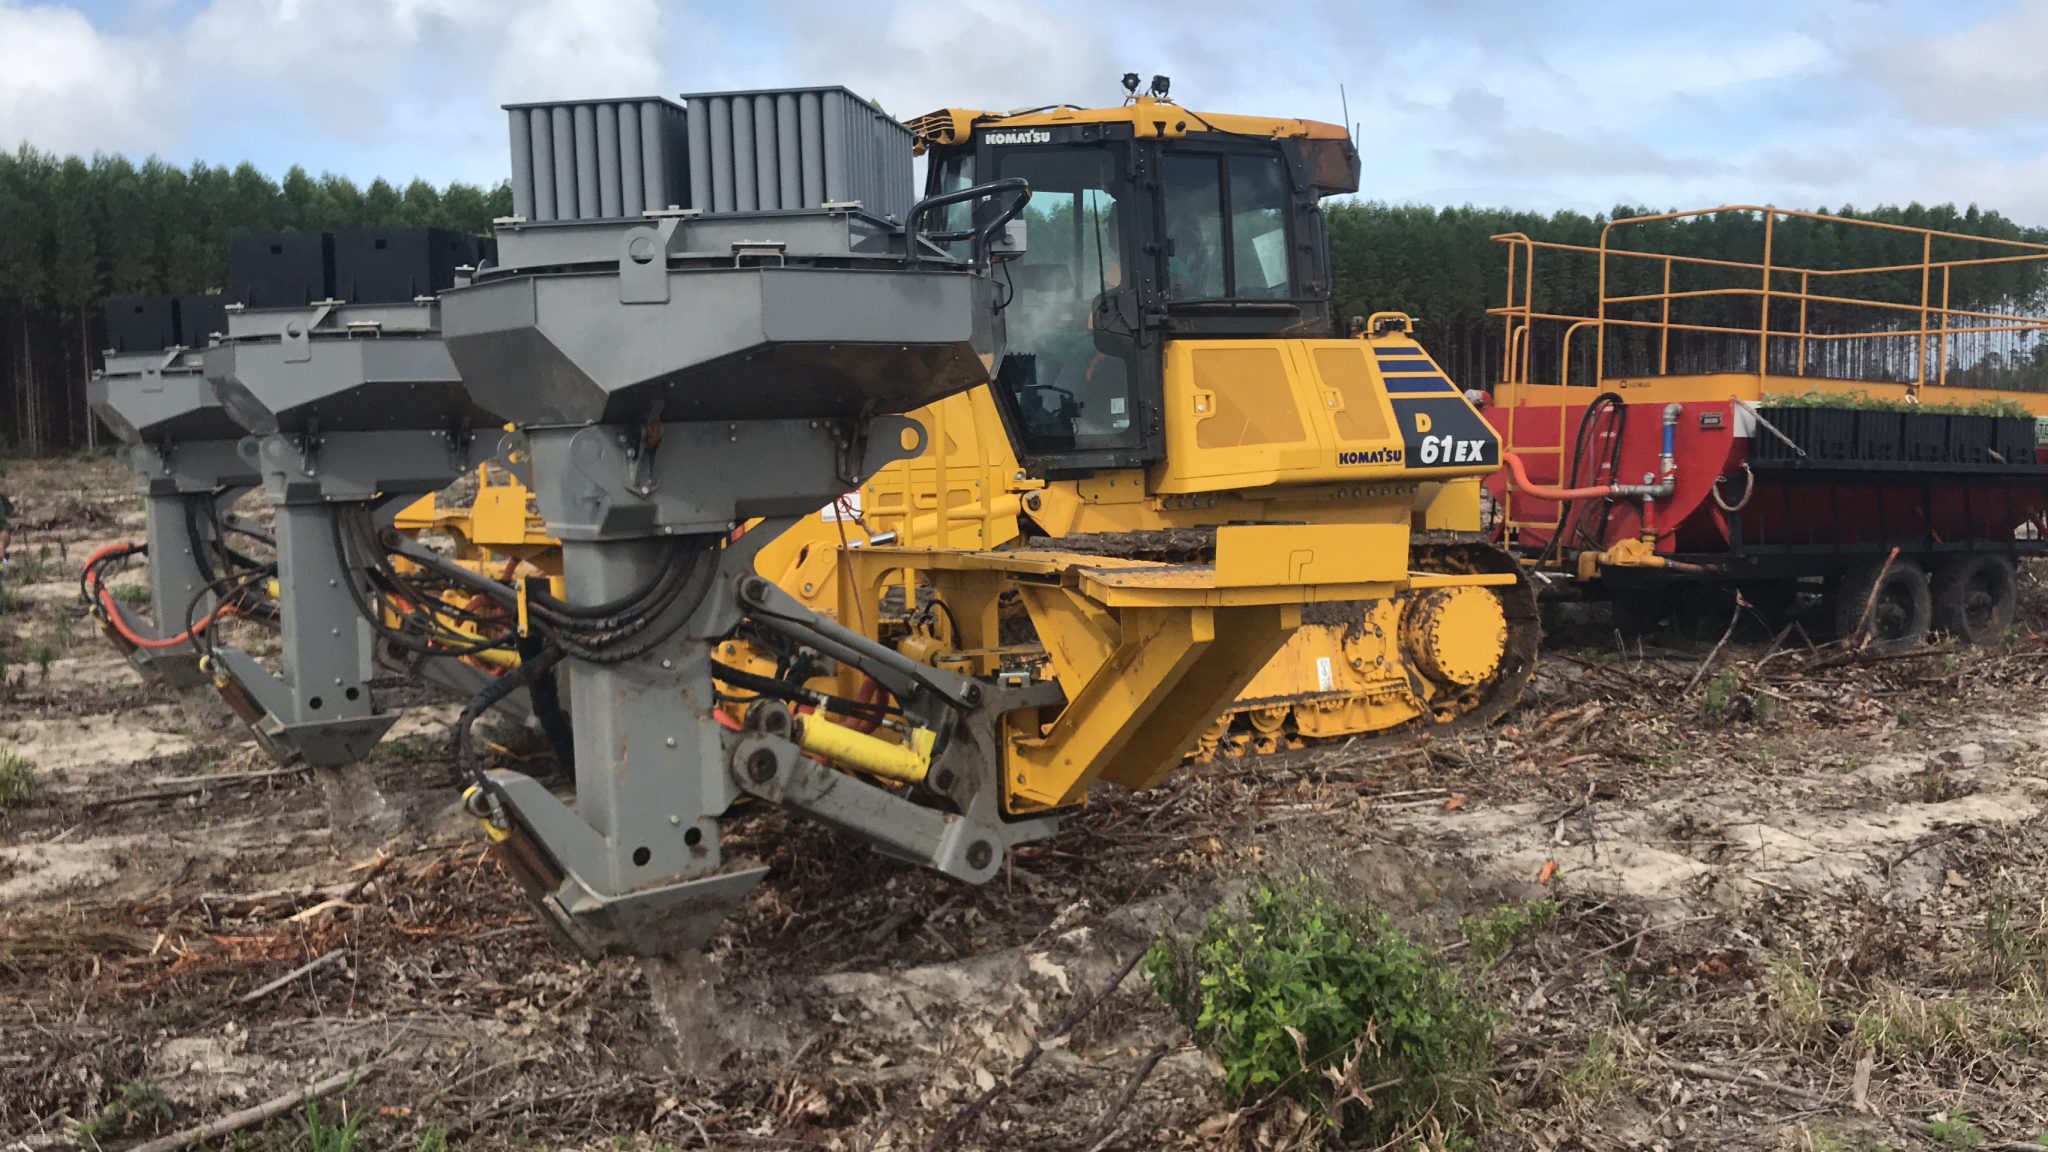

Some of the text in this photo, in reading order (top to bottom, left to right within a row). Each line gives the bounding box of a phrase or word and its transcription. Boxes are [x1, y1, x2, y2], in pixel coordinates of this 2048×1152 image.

[985, 129, 1051, 144] KOMATSU
[1414, 412, 1432, 433] D
[1339, 447, 1402, 464] KOMATSU
[1420, 435, 1486, 464] 61EX
